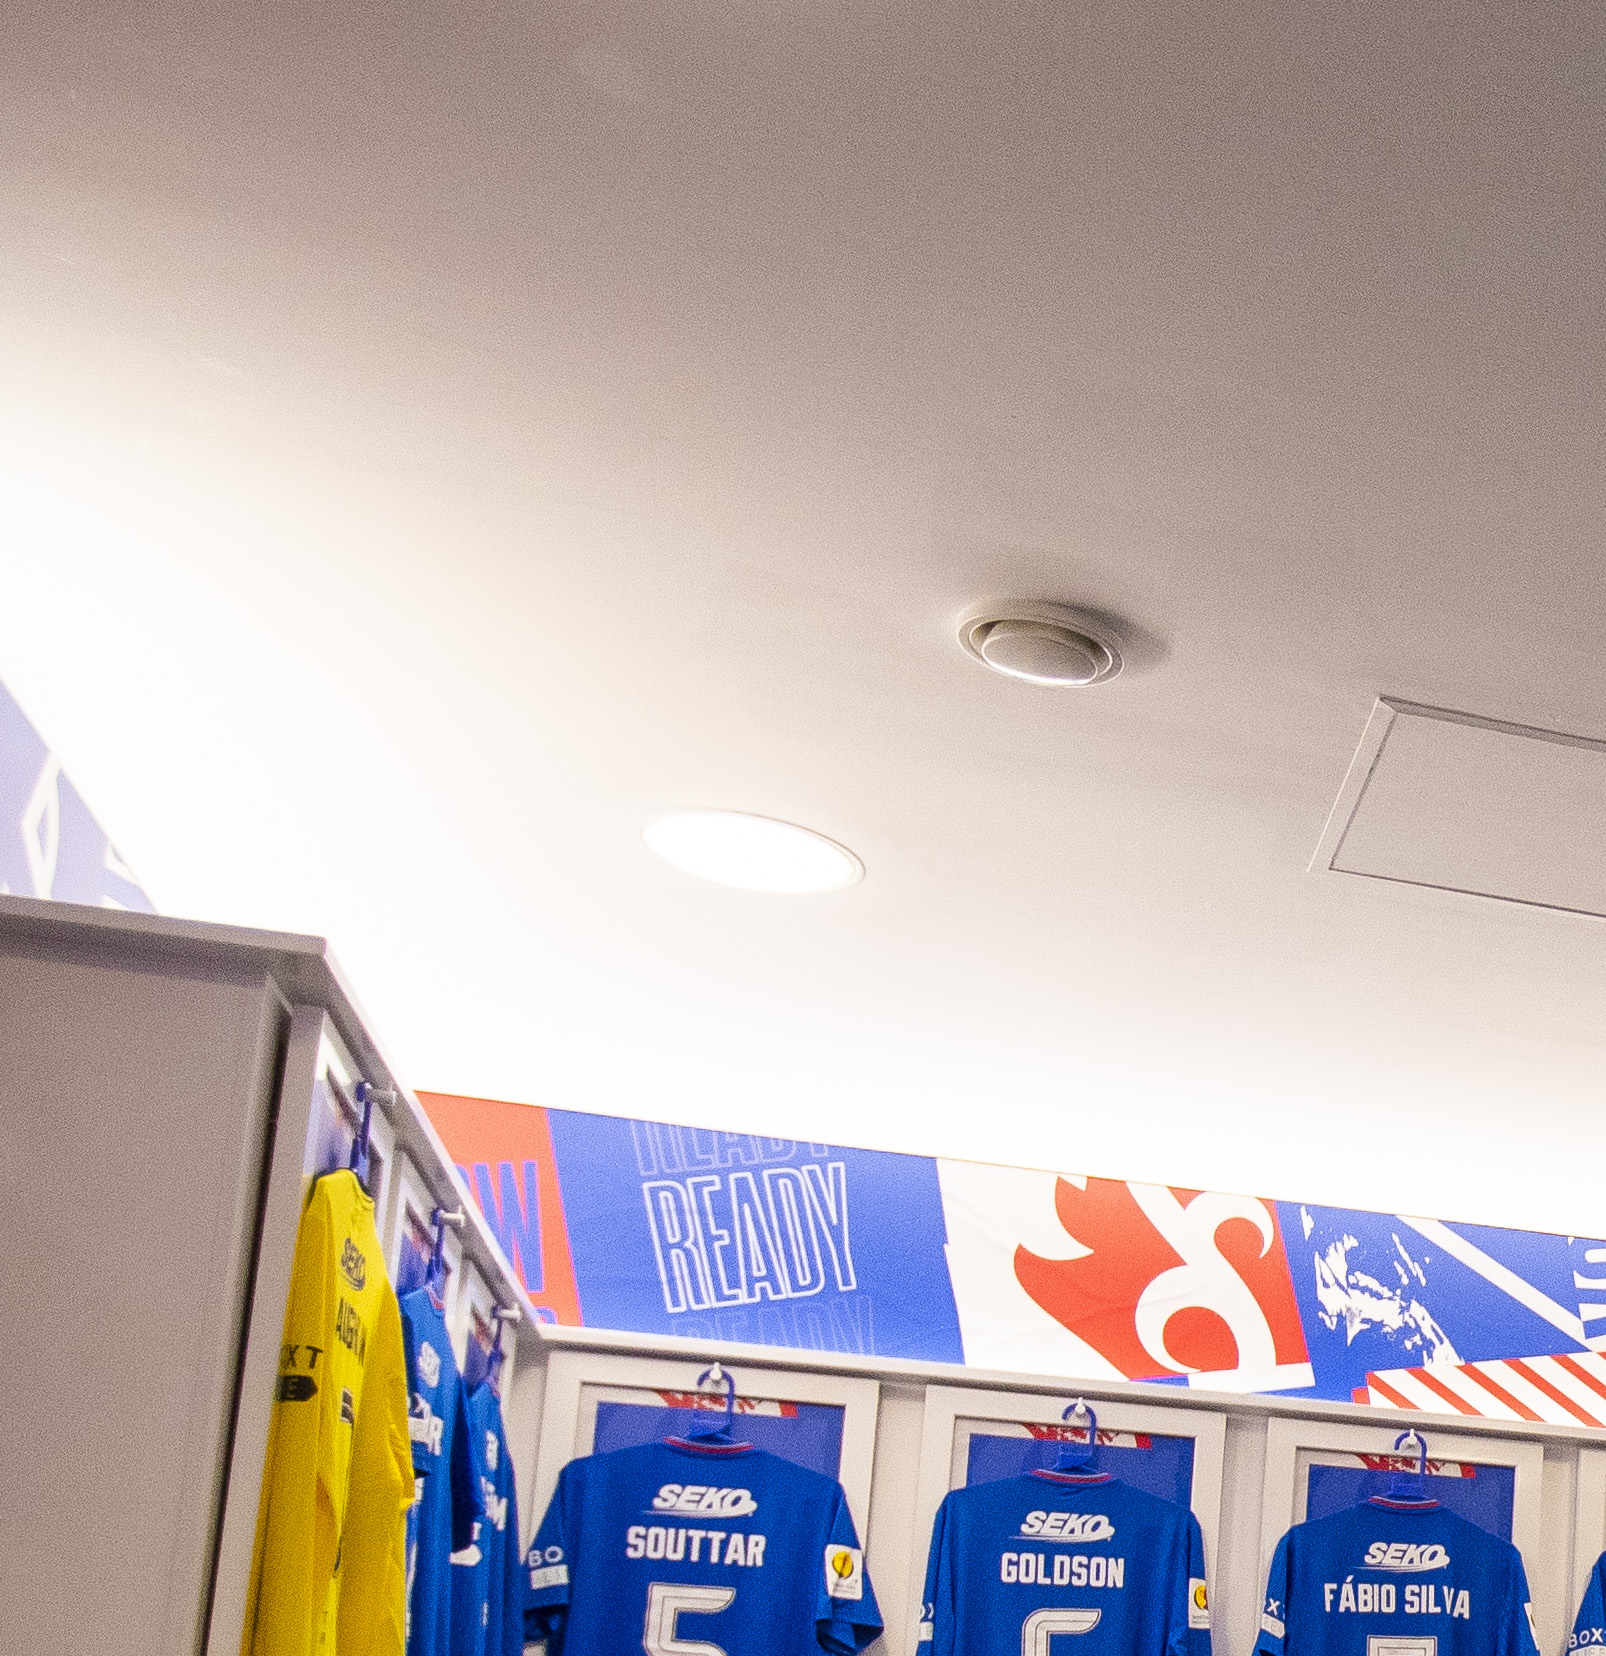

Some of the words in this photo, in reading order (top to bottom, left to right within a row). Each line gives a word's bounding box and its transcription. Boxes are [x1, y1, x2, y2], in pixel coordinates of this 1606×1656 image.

[642, 1161, 857, 1314] READY
[650, 1484, 757, 1517] SEKO
[1019, 1511, 1115, 1541] SEKO
[528, 1546, 565, 1568] BO
[626, 1526, 766, 1567] SOUTTAR
[1364, 1542, 1449, 1571] SEKO
[1001, 1552, 1124, 1588] GOLDSON
[1324, 1575, 1396, 1613] FÁBIO
[1405, 1584, 1470, 1619] SILVA
[1568, 1627, 1606, 1649] BOX
